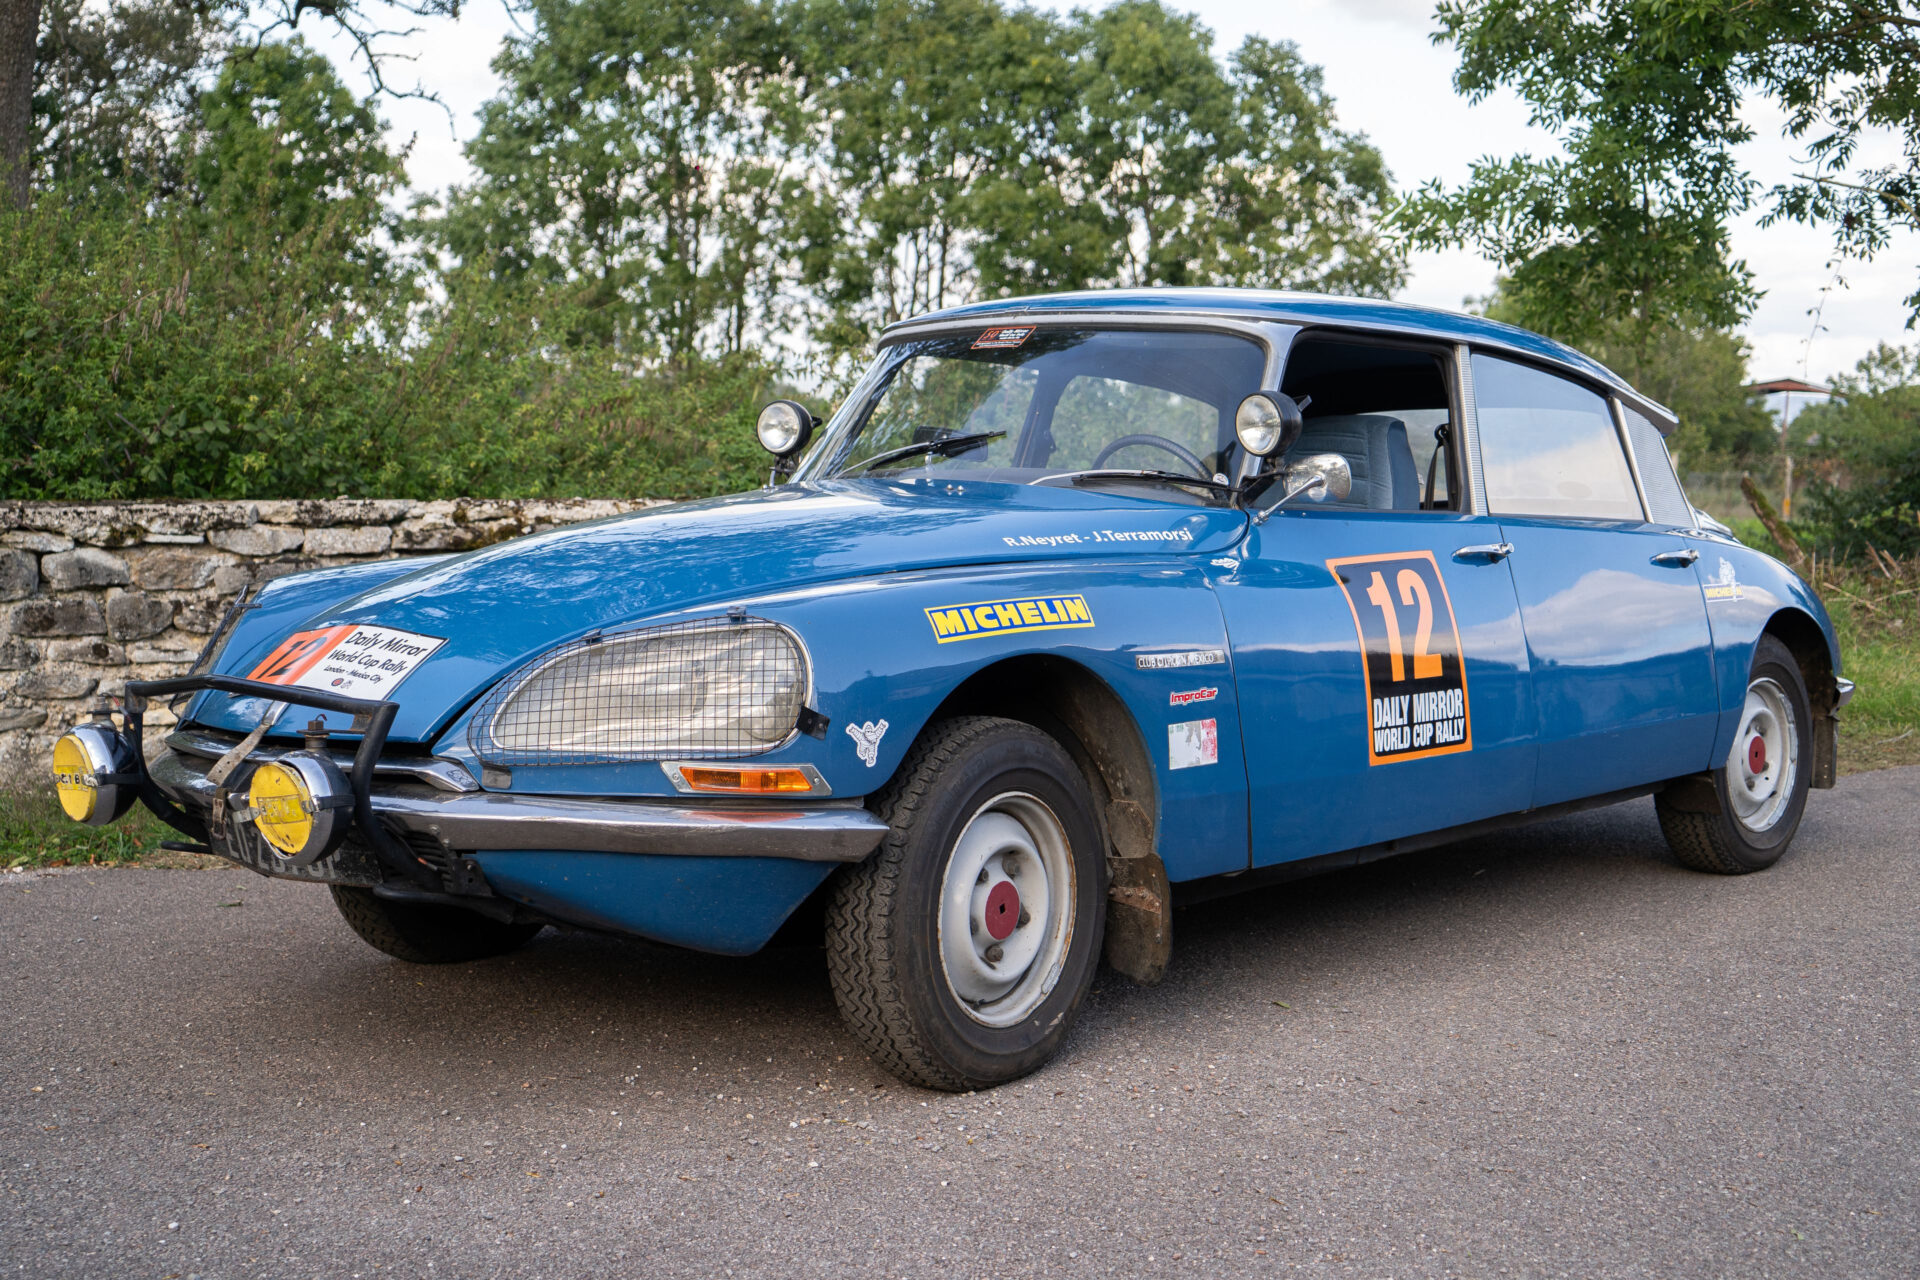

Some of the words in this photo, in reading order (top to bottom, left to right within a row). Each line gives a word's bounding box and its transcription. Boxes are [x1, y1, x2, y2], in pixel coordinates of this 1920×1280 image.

[1002, 533, 1083, 547] R.Neyret
[1092, 527, 1194, 543] J.Terramorsi
[930, 598, 1089, 636] MICHELIN
[1365, 568, 1444, 682] 12
[256, 636, 328, 679] 12
[344, 631, 384, 651] Daily
[381, 637, 428, 657] Mirror
[323, 665, 345, 675] London
[349, 669, 370, 681] Mexico
[369, 674, 383, 684] City
[327, 649, 357, 664] World
[358, 653, 381, 668] Cup
[380, 658, 408, 676] Rally
[1171, 688, 1217, 704] ImproCar
[1373, 694, 1411, 728] DAILY
[1412, 688, 1464, 723] MIRROR
[1373, 725, 1411, 753] WORLD
[1413, 723, 1434, 748] CUP
[1435, 717, 1465, 744] RALLY
